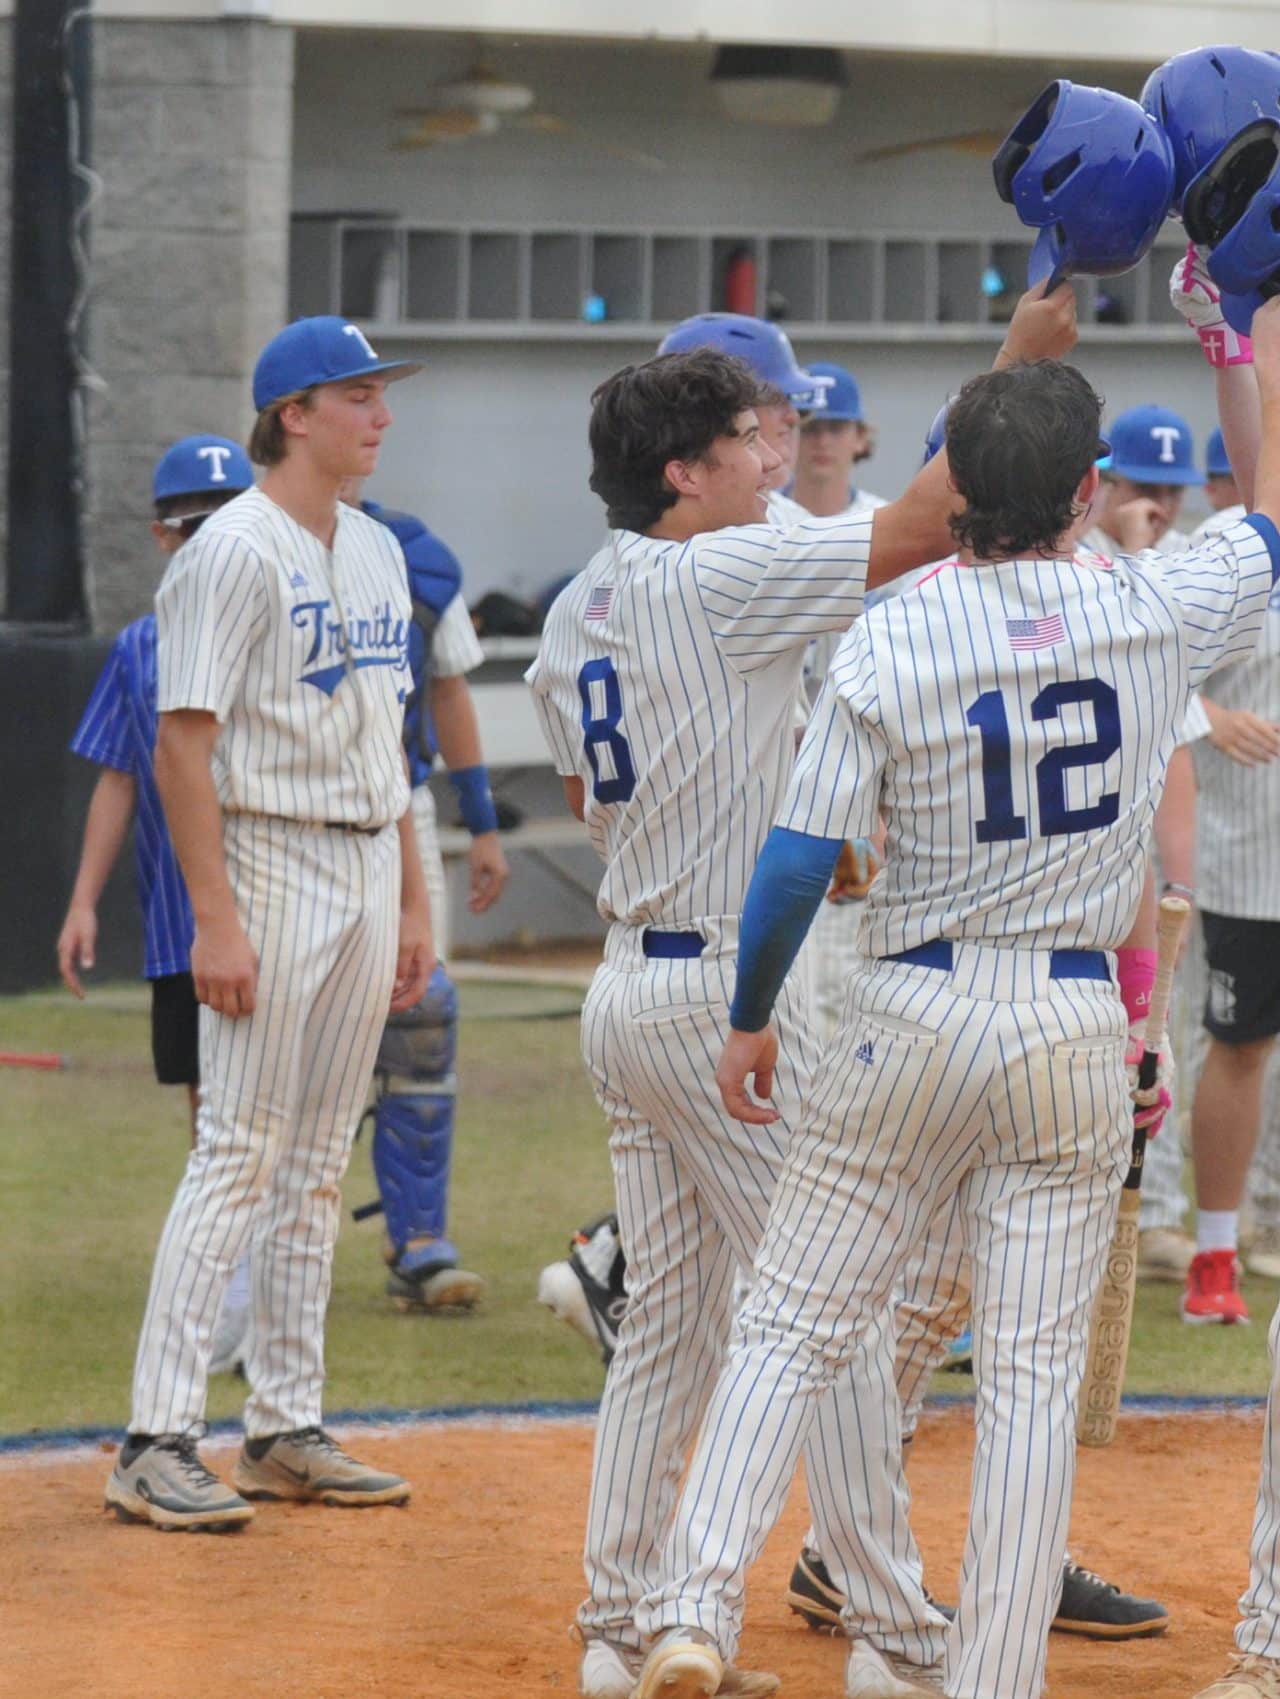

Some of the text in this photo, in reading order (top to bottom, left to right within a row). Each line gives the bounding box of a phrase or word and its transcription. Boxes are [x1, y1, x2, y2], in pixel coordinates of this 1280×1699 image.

[341, 324, 379, 360] T
[196, 446, 232, 483] T
[1151, 426, 1181, 463] T
[290, 600, 409, 671] Trinity
[577, 655, 637, 805] 8
[966, 677, 1122, 844] 12
